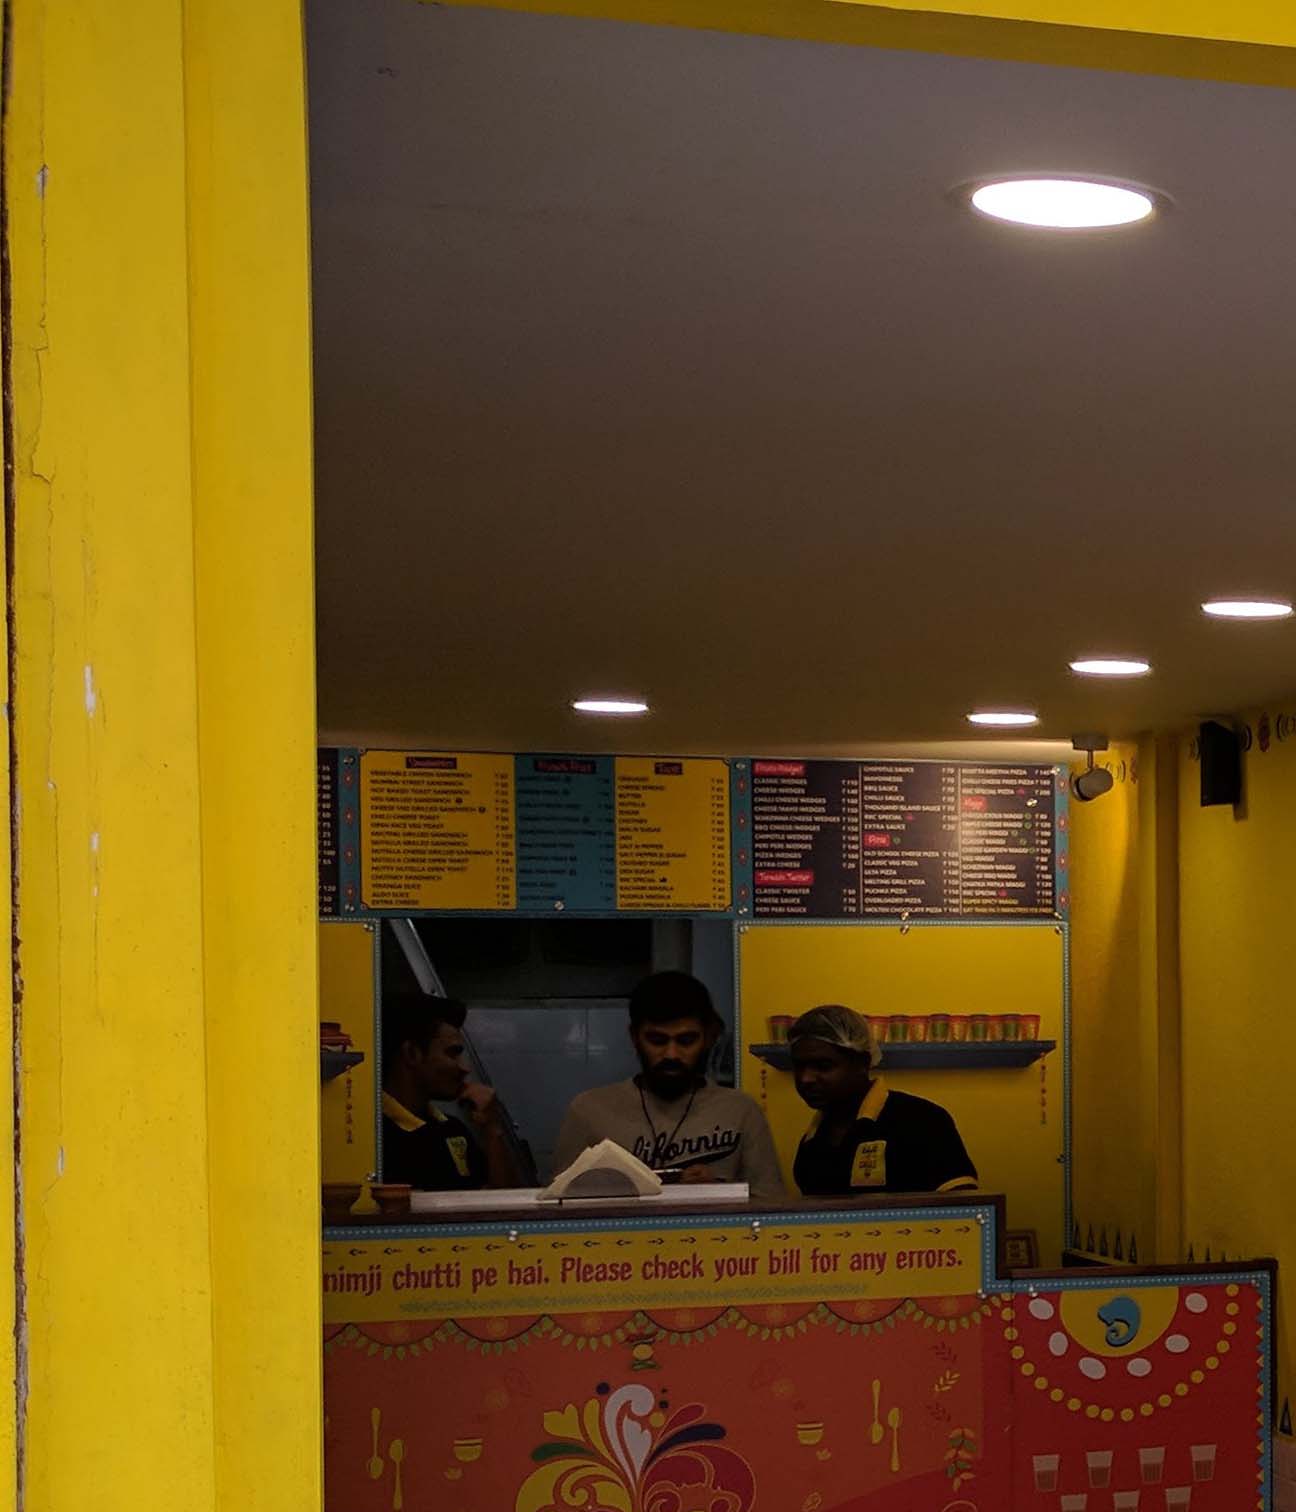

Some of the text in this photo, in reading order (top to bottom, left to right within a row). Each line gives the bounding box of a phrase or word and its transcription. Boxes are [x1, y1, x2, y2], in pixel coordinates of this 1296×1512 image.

[392, 1262, 461, 1291] chutti
[472, 1265, 498, 1294] pe
[508, 1258, 550, 1286] hai.
[560, 1255, 633, 1284] Please
[641, 1252, 705, 1281] check
[713, 1255, 760, 1284] your
[768, 1248, 802, 1276] bill
[810, 1248, 841, 1274] for
[848, 1251, 888, 1276] any
[895, 1247, 963, 1271] errors.
